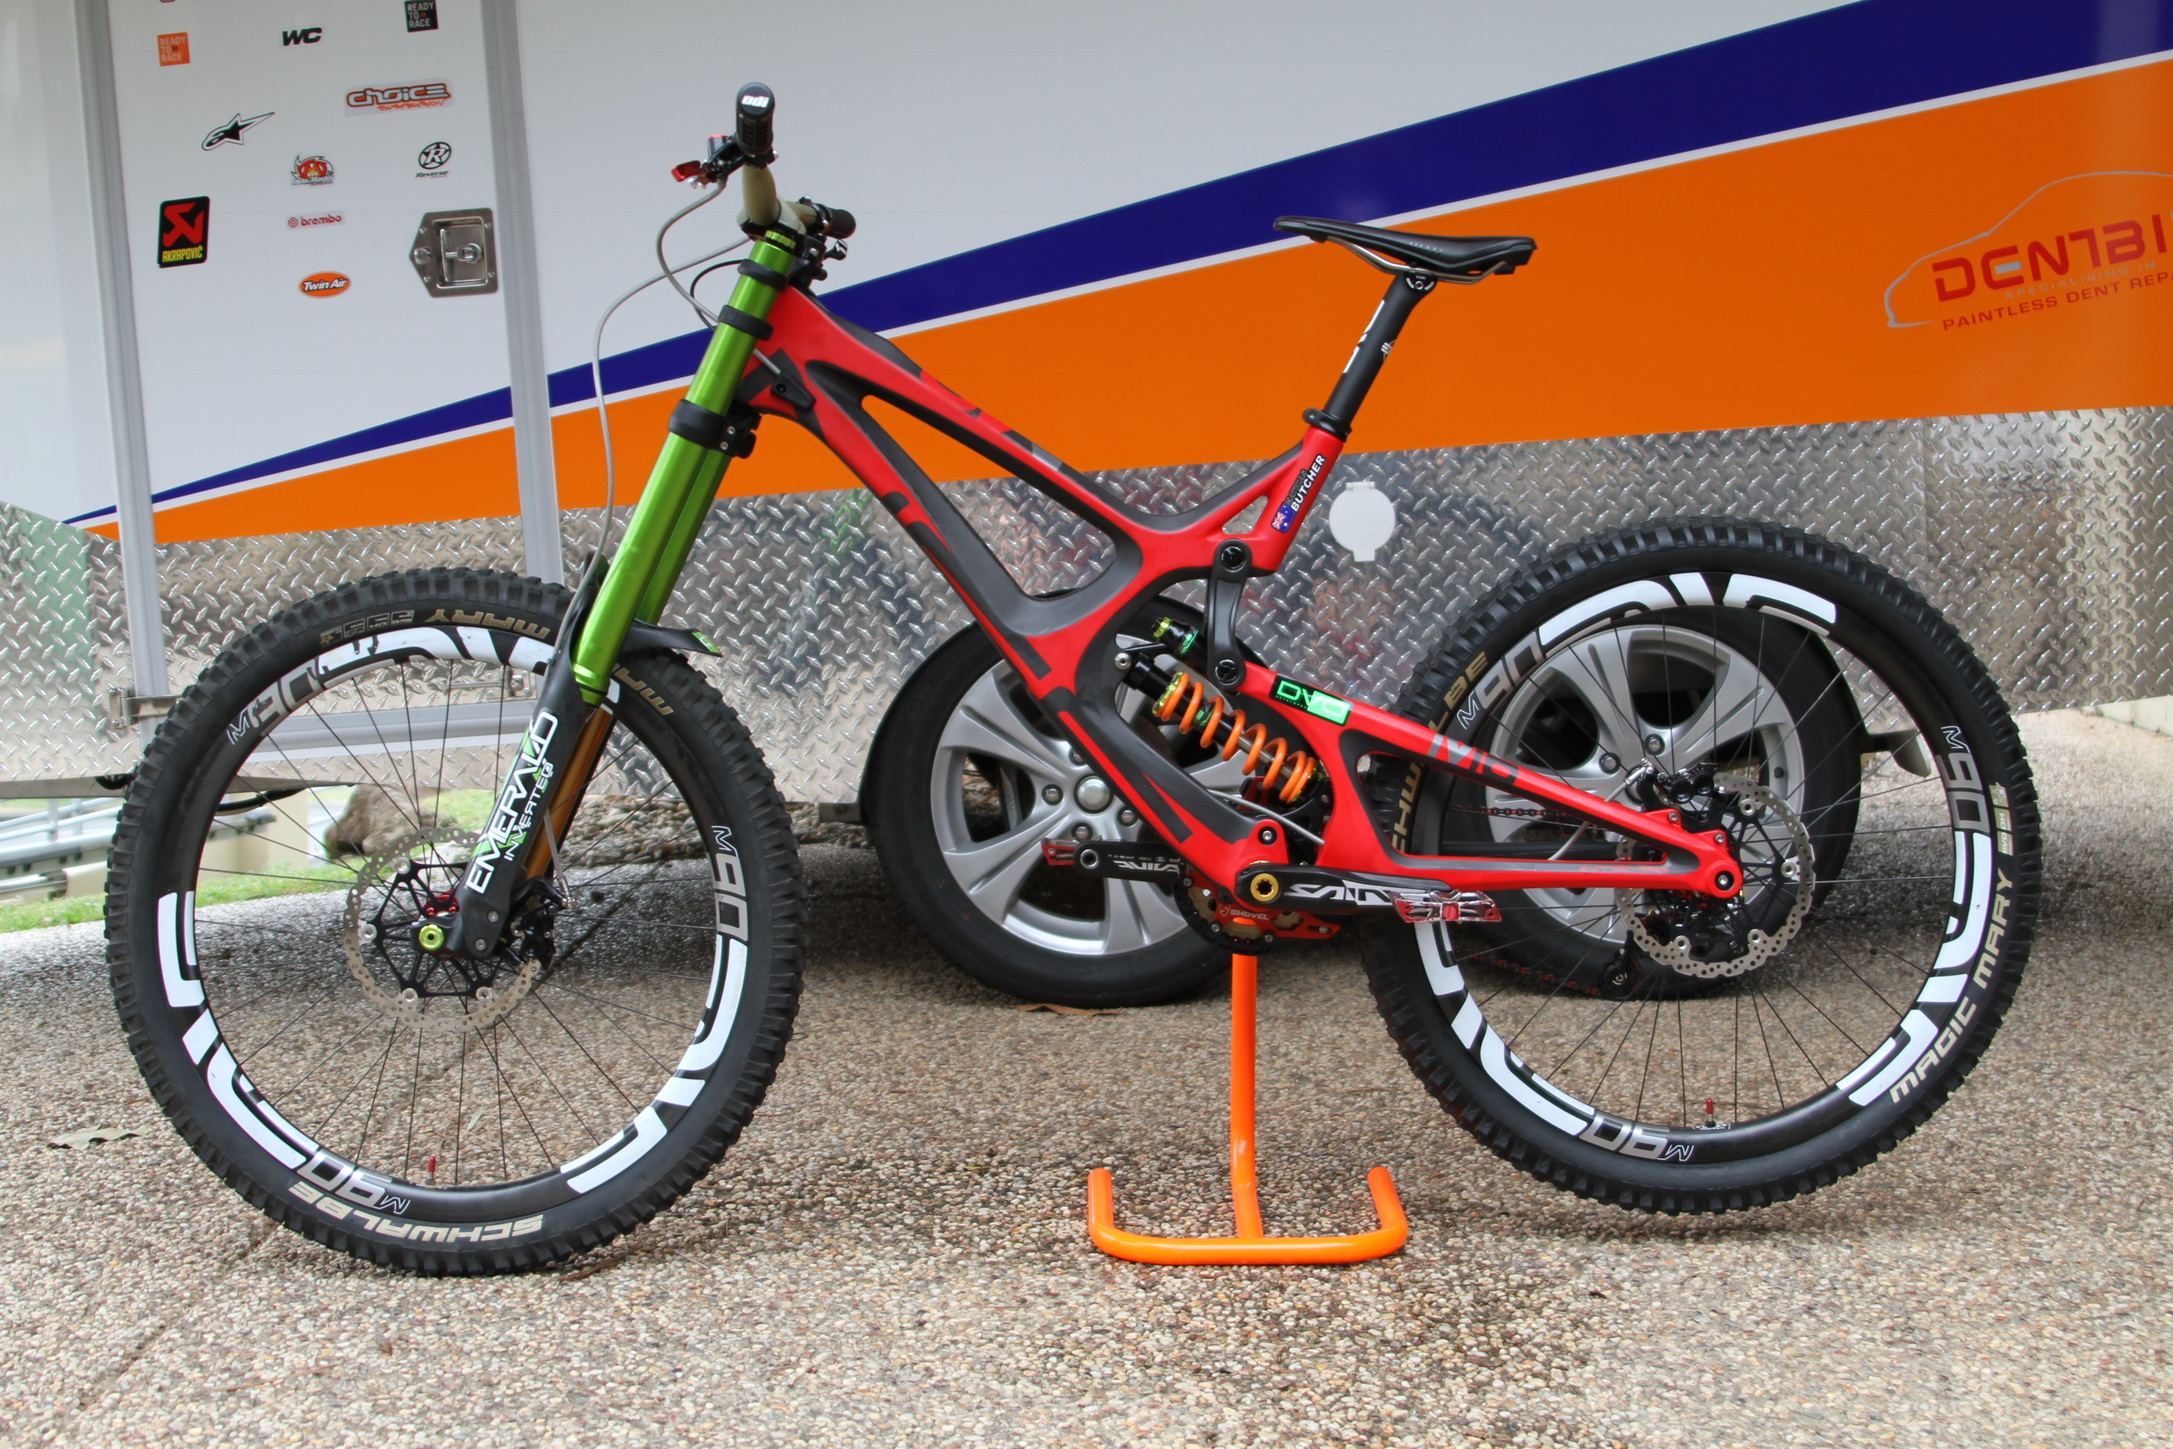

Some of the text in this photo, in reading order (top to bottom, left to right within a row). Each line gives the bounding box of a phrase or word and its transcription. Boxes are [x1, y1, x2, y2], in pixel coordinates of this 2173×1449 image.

[407, 2, 434, 12] READY
[408, 11, 420, 20] TO
[282, 27, 322, 46] WC
[408, 18, 431, 29] RACE
[300, 214, 342, 227] brembo
[304, 278, 348, 291] Twin Air
[2004, 261, 2157, 299] SPECIALISING IN
[1942, 271, 2173, 331] PAINTLESS DENT REP
[1290, 455, 1326, 512] BUTCHER
[466, 711, 559, 894] EMERALD
[504, 758, 554, 861] INVERTED
[1230, 909, 1269, 920] SHOVEL
[1889, 996, 1978, 1104] MAGIC
[1972, 868, 2013, 990] MARY
[288, 1181, 545, 1244] SCHWALBE
